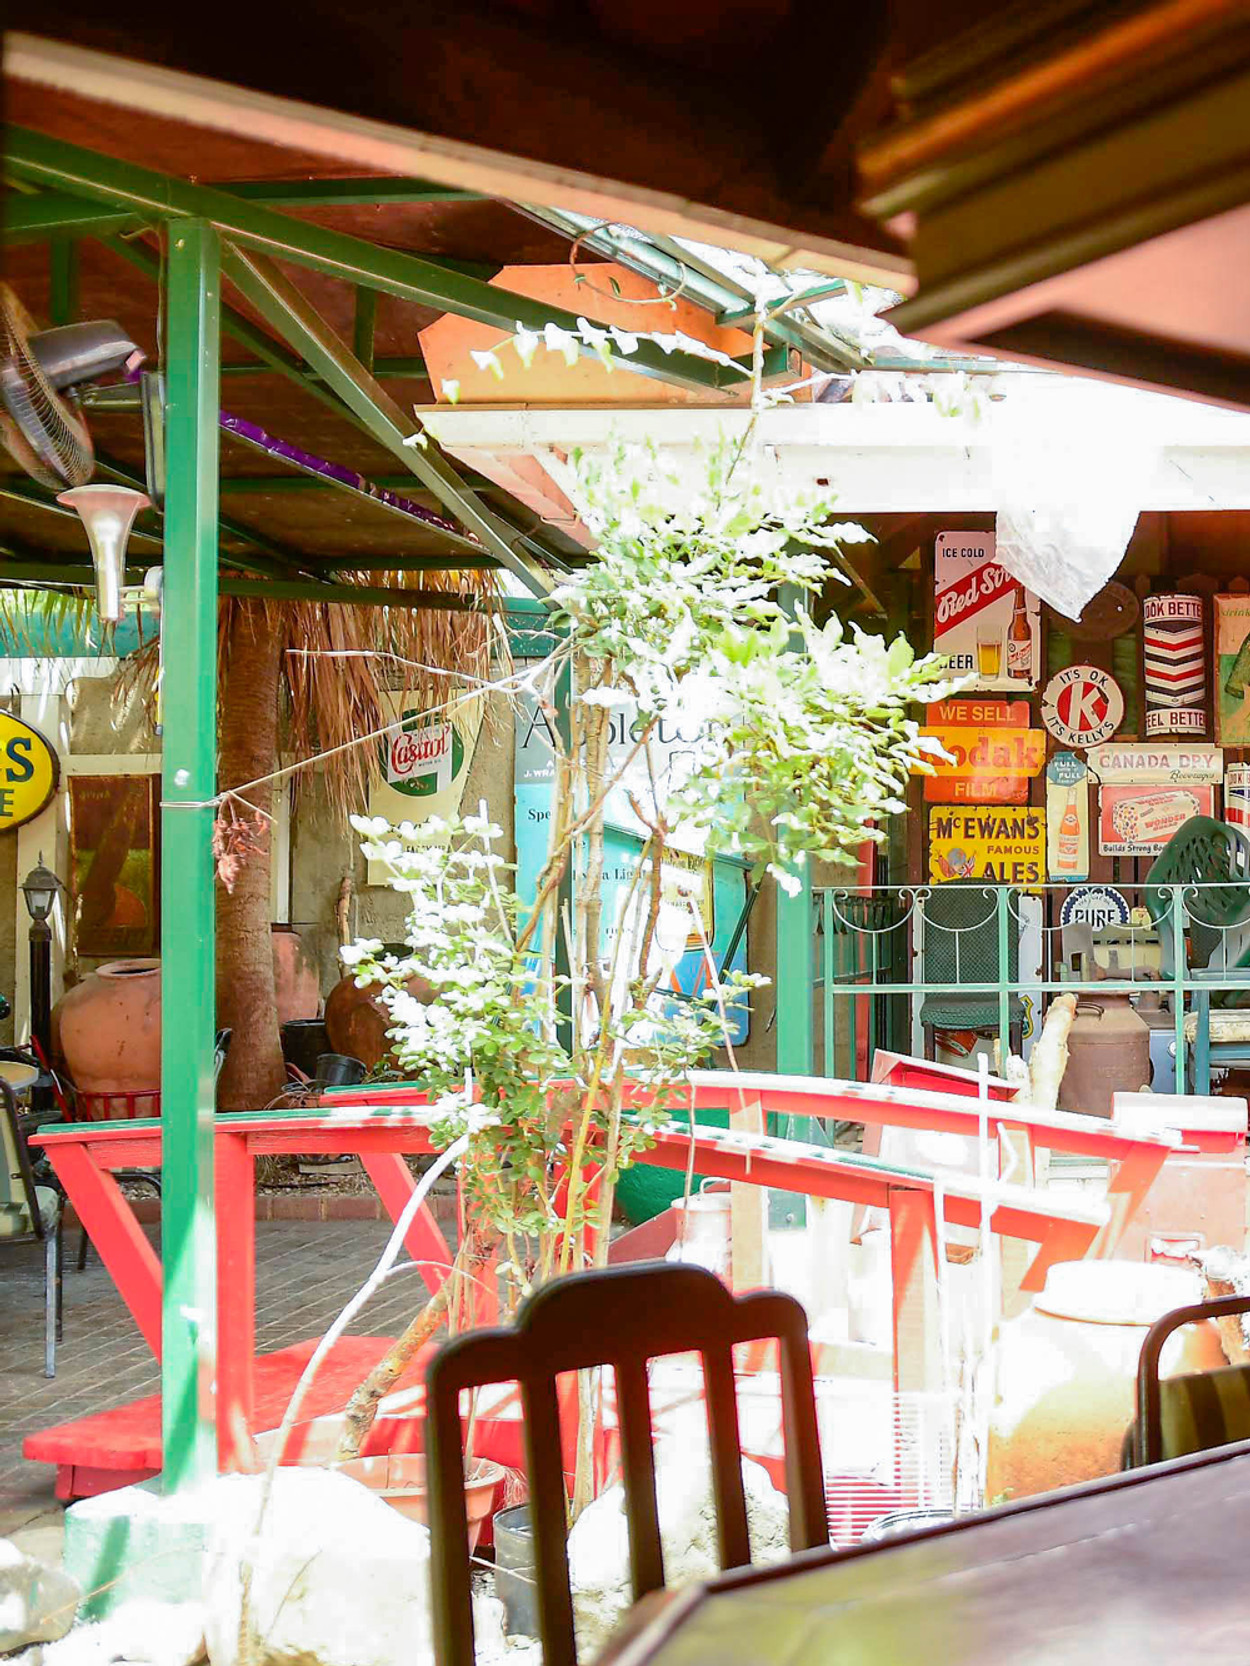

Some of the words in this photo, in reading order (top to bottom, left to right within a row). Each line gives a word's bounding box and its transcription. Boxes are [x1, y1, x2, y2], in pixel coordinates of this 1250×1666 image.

[942, 548, 957, 558] ICE
[961, 548, 985, 558] COLD
[937, 577, 980, 623] Red
[980, 567, 1013, 595] Str
[1146, 602, 1165, 618] OOK
[1168, 602, 1201, 616] BETTE
[939, 654, 973, 669] EER
[1059, 669, 1080, 684] IT'S
[939, 706, 967, 721] WE
[972, 706, 1016, 721] SELL
[1147, 712, 1164, 727] EEL
[1170, 711, 1204, 725] BETTE
[520, 705, 727, 748] Apleton
[1068, 721, 1114, 744] KELLY'S
[1100, 754, 1170, 769] CANADA
[1179, 754, 1215, 768] DRY
[533, 770, 555, 778] WRA
[1228, 773, 1242, 784] OOK
[955, 782, 996, 797] FILM
[528, 809, 551, 824] Spe
[987, 846, 1039, 855] FAMOUS
[1103, 844, 1125, 852] Builds
[1128, 844, 1151, 853] Strong
[982, 862, 1039, 884] ALES
[1075, 909, 1116, 927] PURE
